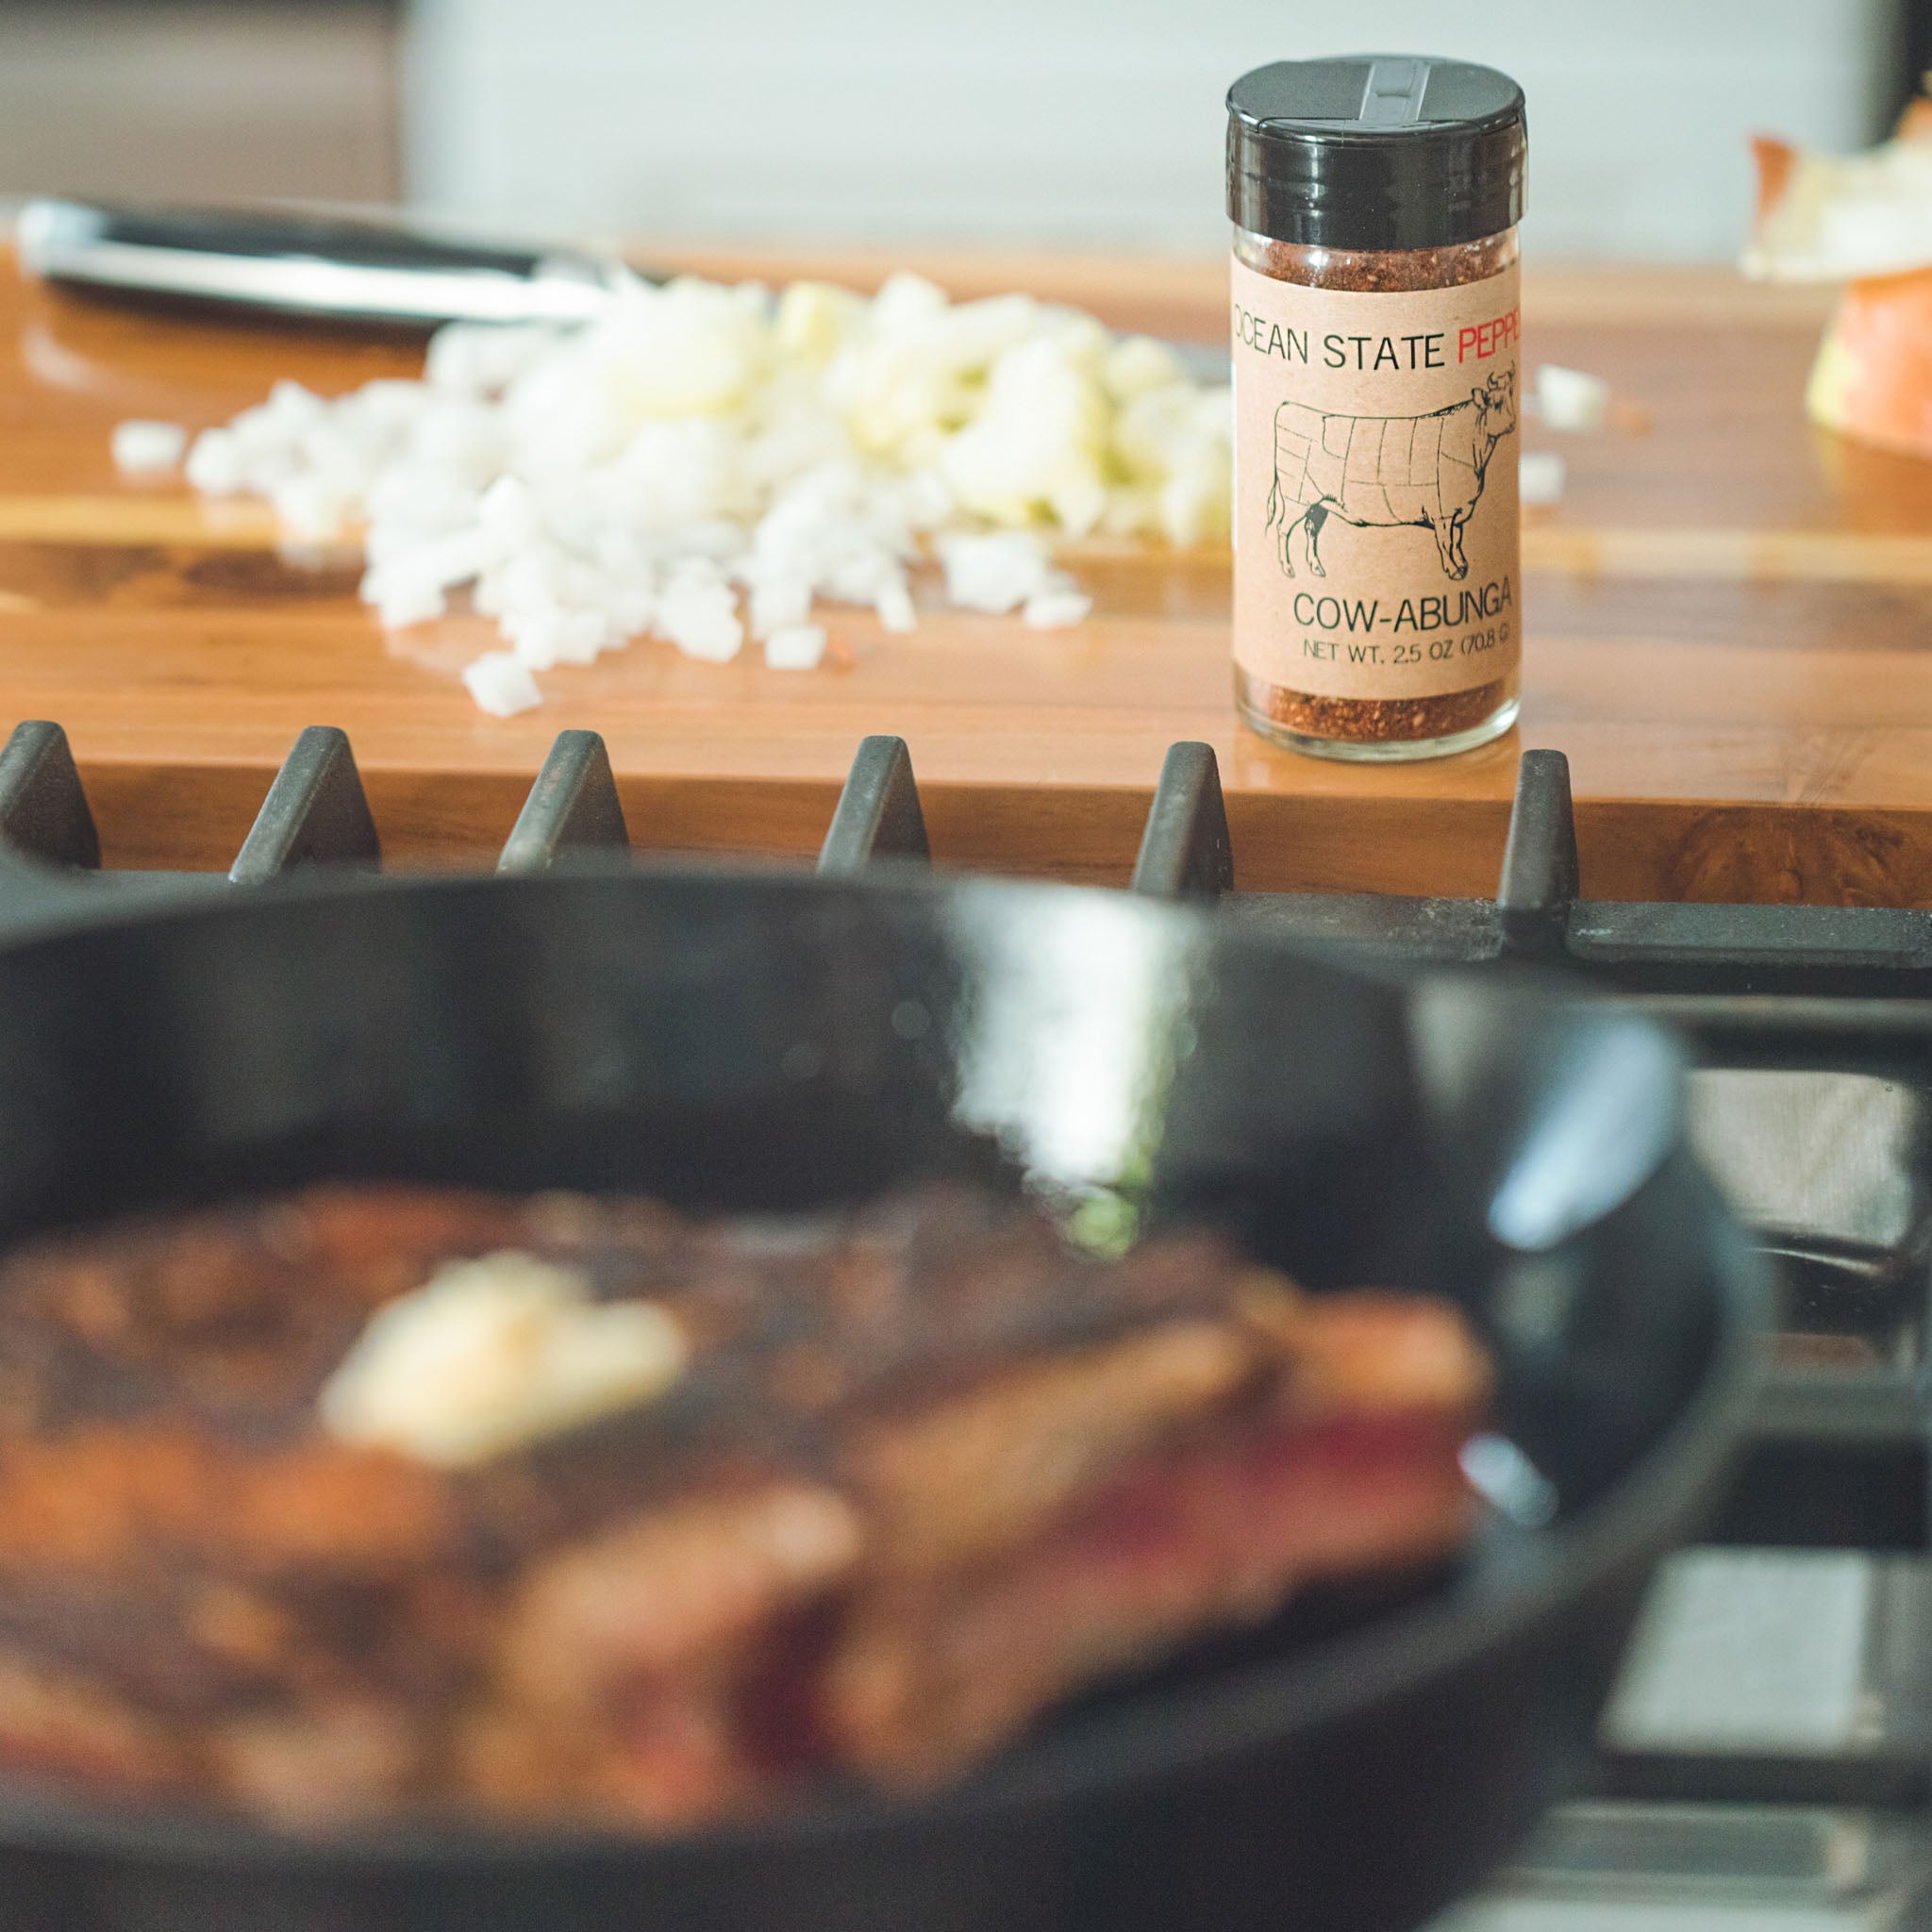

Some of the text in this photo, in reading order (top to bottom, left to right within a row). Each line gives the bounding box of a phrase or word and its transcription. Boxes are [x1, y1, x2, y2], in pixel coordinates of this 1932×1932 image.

[1234, 303, 1308, 365] OCEAN
[1323, 332, 1445, 371] STATE
[1293, 575, 1512, 633] COW-ABUNGA
[1303, 638, 1341, 661] NET
[1348, 643, 1386, 665] WT.
[1392, 643, 1423, 664] 2.5
[1428, 639, 1454, 661] OZ
